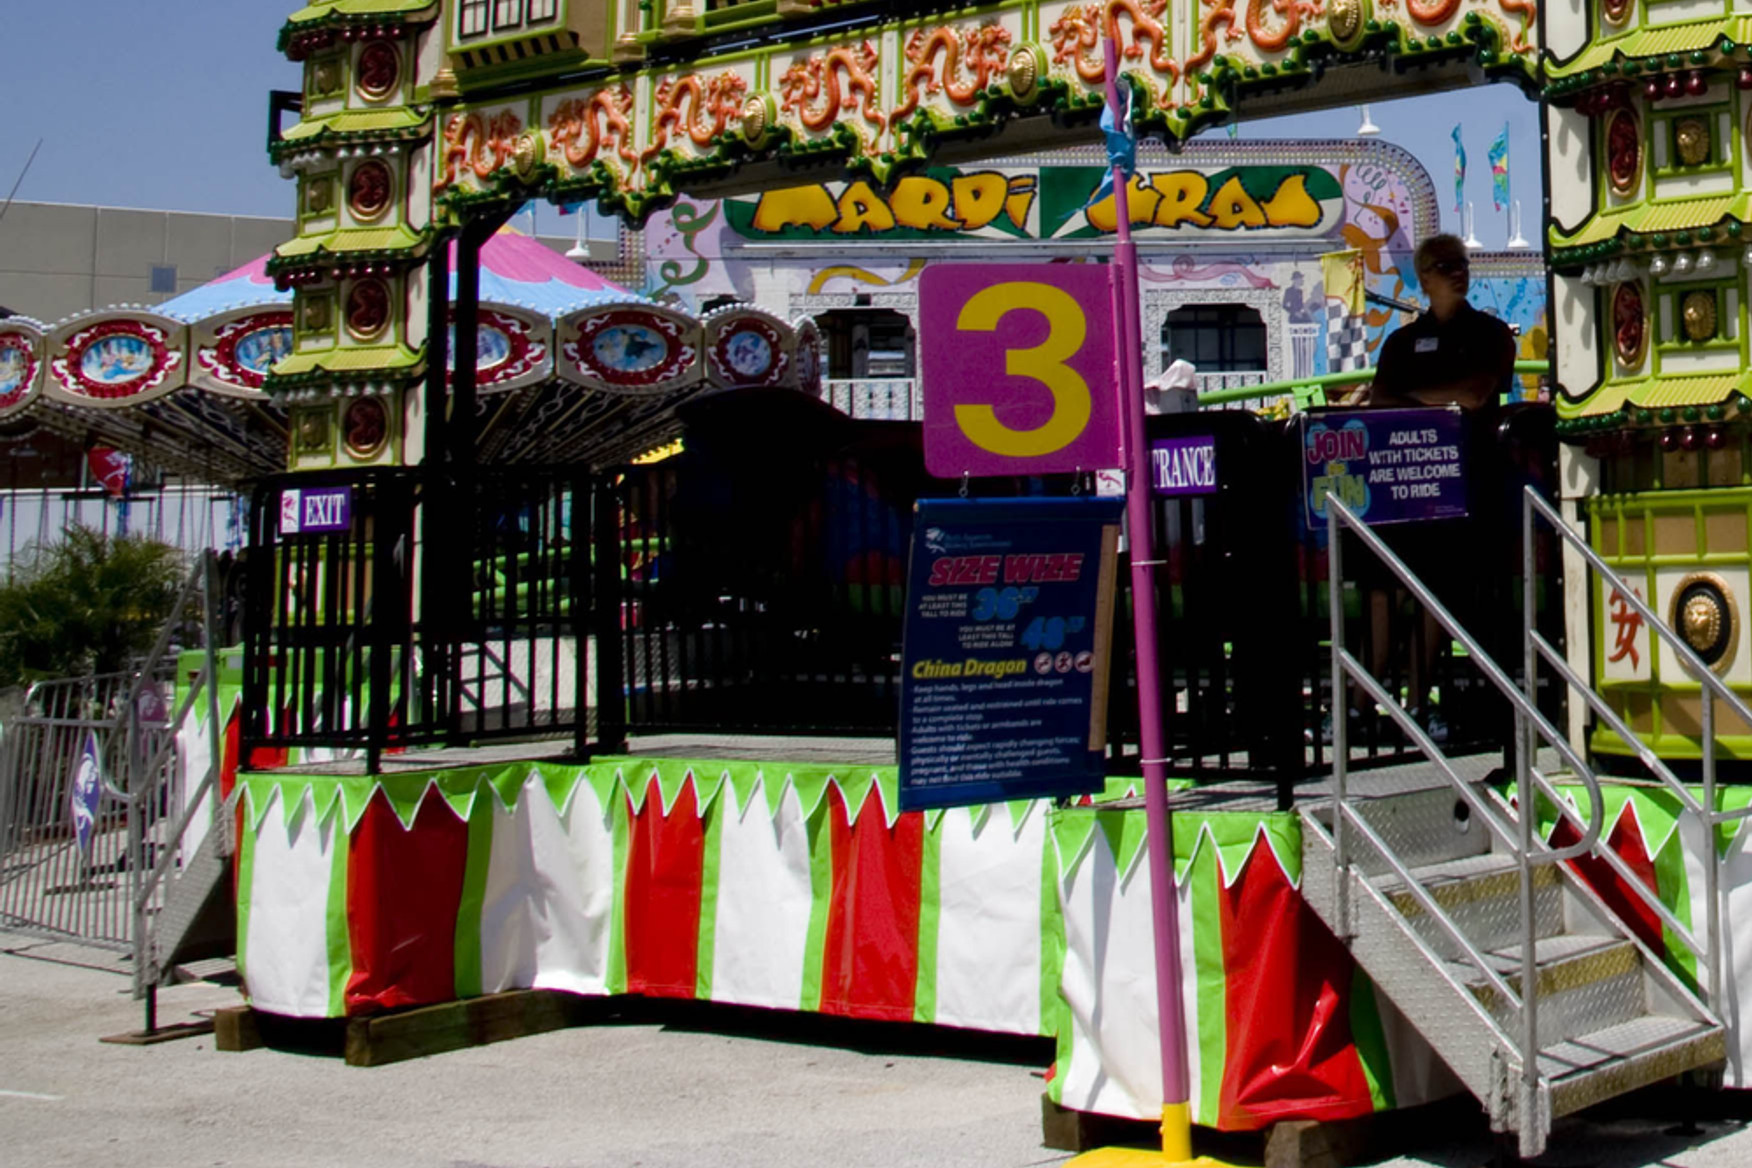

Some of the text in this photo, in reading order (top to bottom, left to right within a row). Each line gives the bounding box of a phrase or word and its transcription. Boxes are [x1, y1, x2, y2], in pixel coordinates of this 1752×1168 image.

[1088, 172, 1321, 231] GRAS
[954, 281, 1092, 457] 3
[1307, 429, 1365, 464] JOIN
[1389, 428, 1438, 446] ADULTS
[1369, 446, 1459, 465] WITH TICKETS
[1369, 464, 1461, 483] ARE WELCOME
[1311, 474, 1366, 510] FUN
[1390, 483, 1441, 500] TO RIDE
[304, 494, 344, 526] EXIT
[928, 552, 1085, 587] SIZE WIZE
[912, 657, 1028, 679] China Dragon
